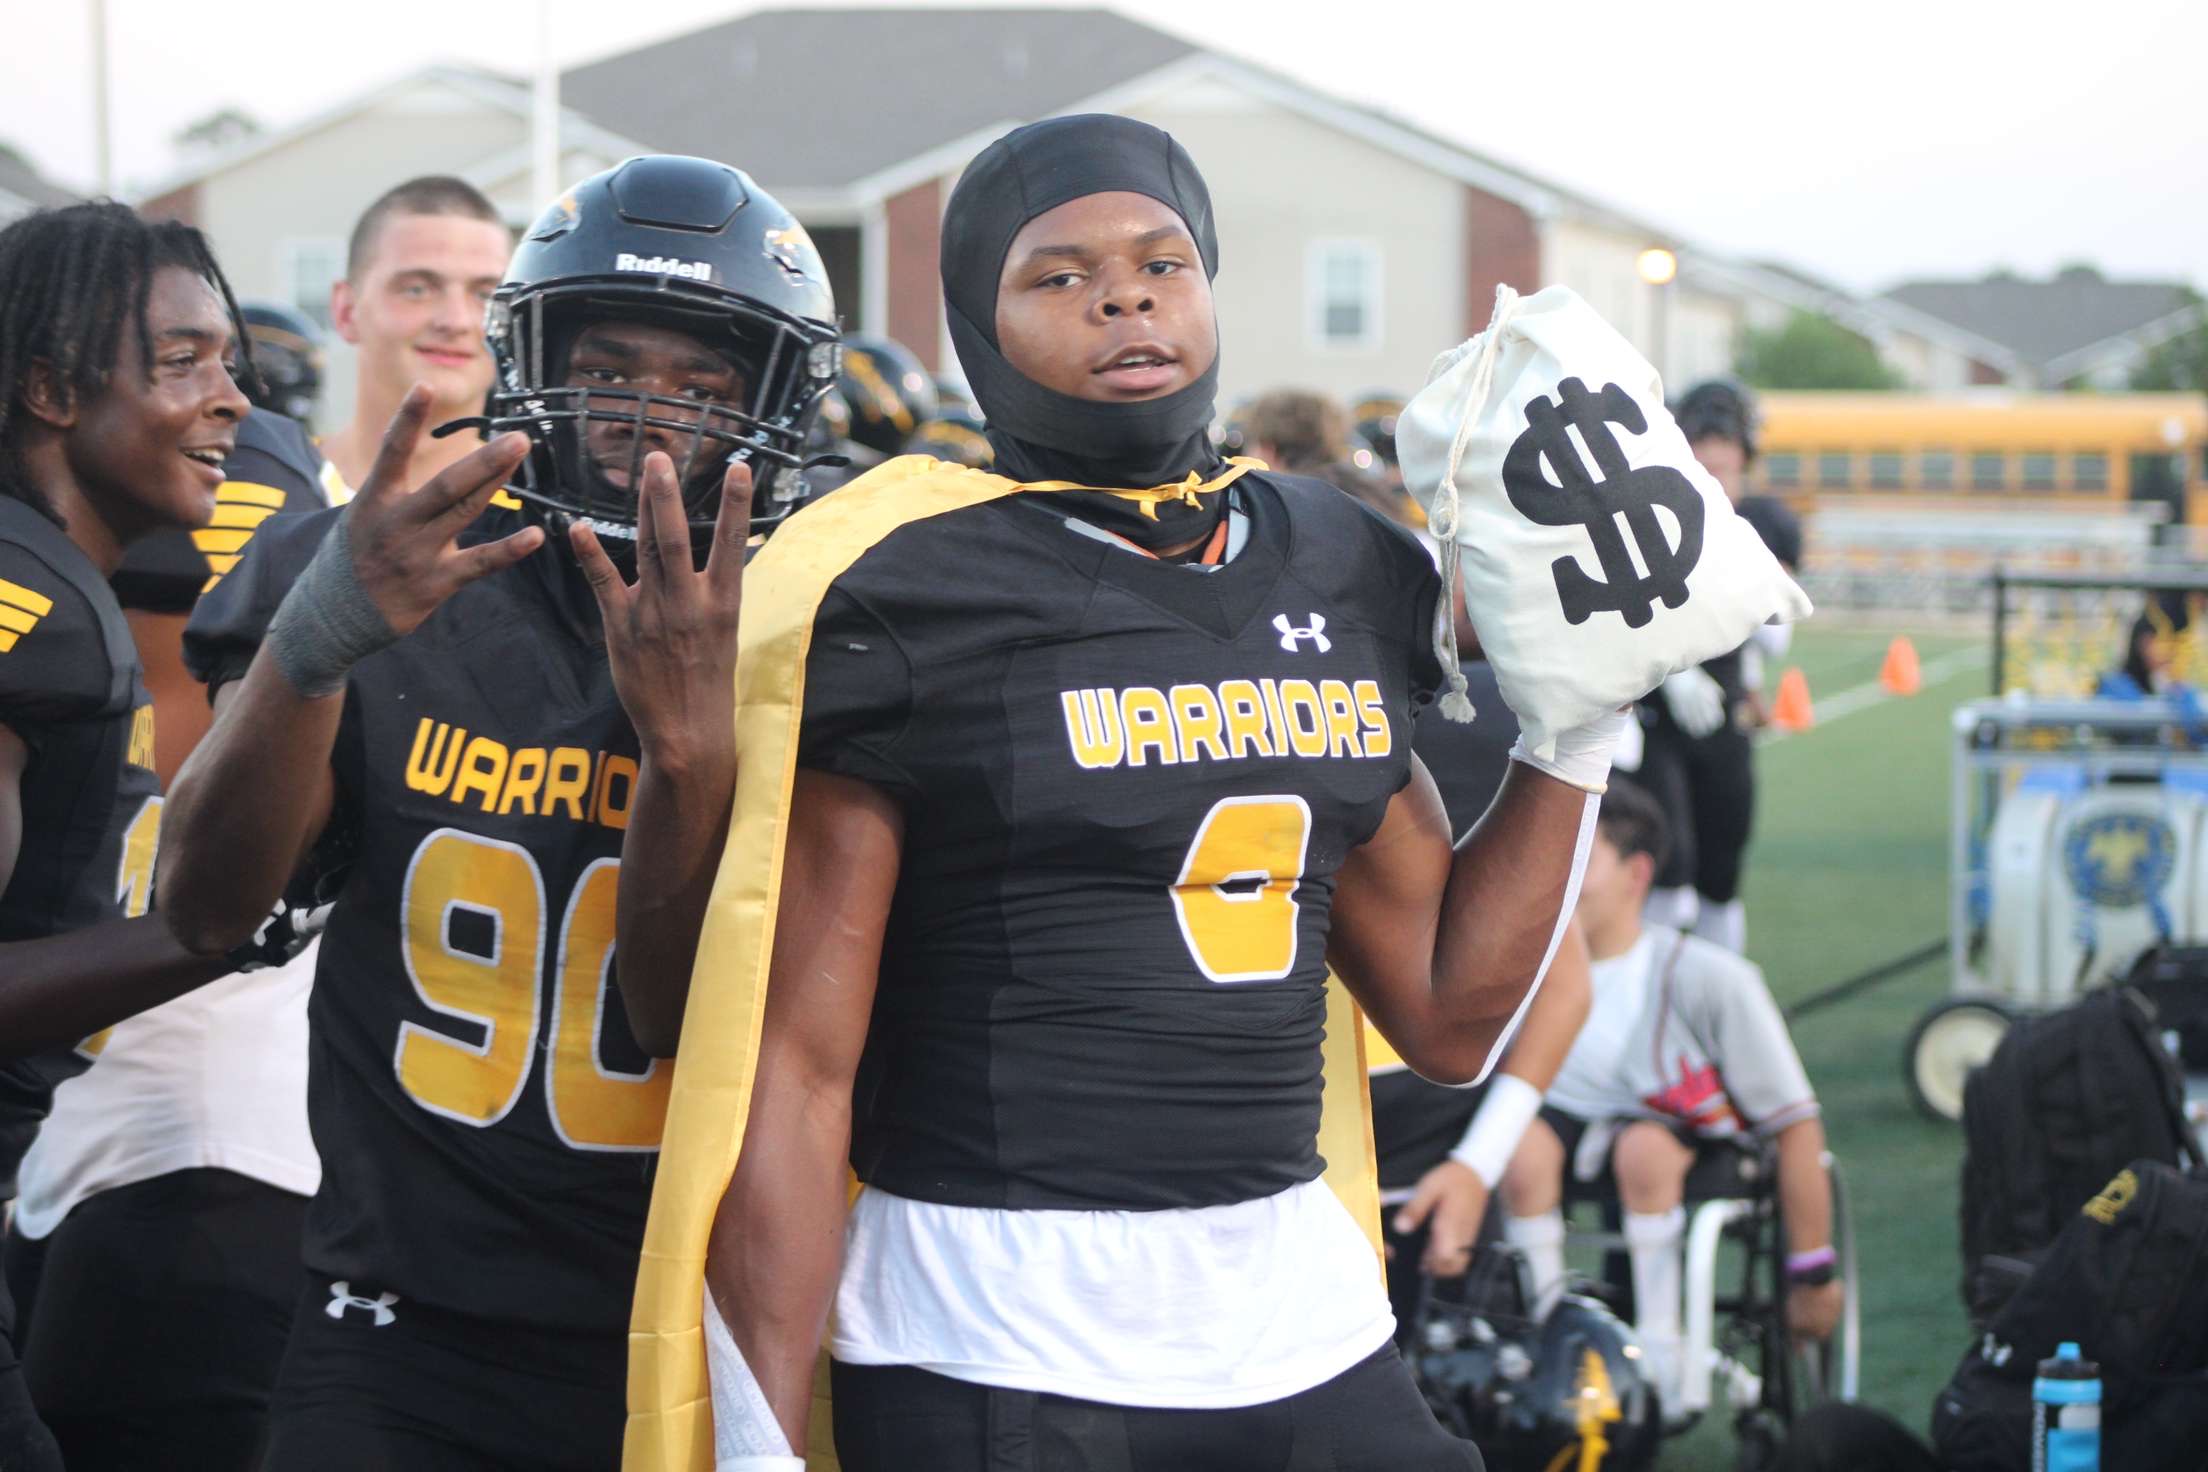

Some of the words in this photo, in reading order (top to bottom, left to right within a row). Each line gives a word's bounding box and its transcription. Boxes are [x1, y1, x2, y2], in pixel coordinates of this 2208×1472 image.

[615, 253, 713, 281] Riddell
[1061, 679, 1391, 769] WARRIORS
[405, 717, 640, 830] WARRIO
